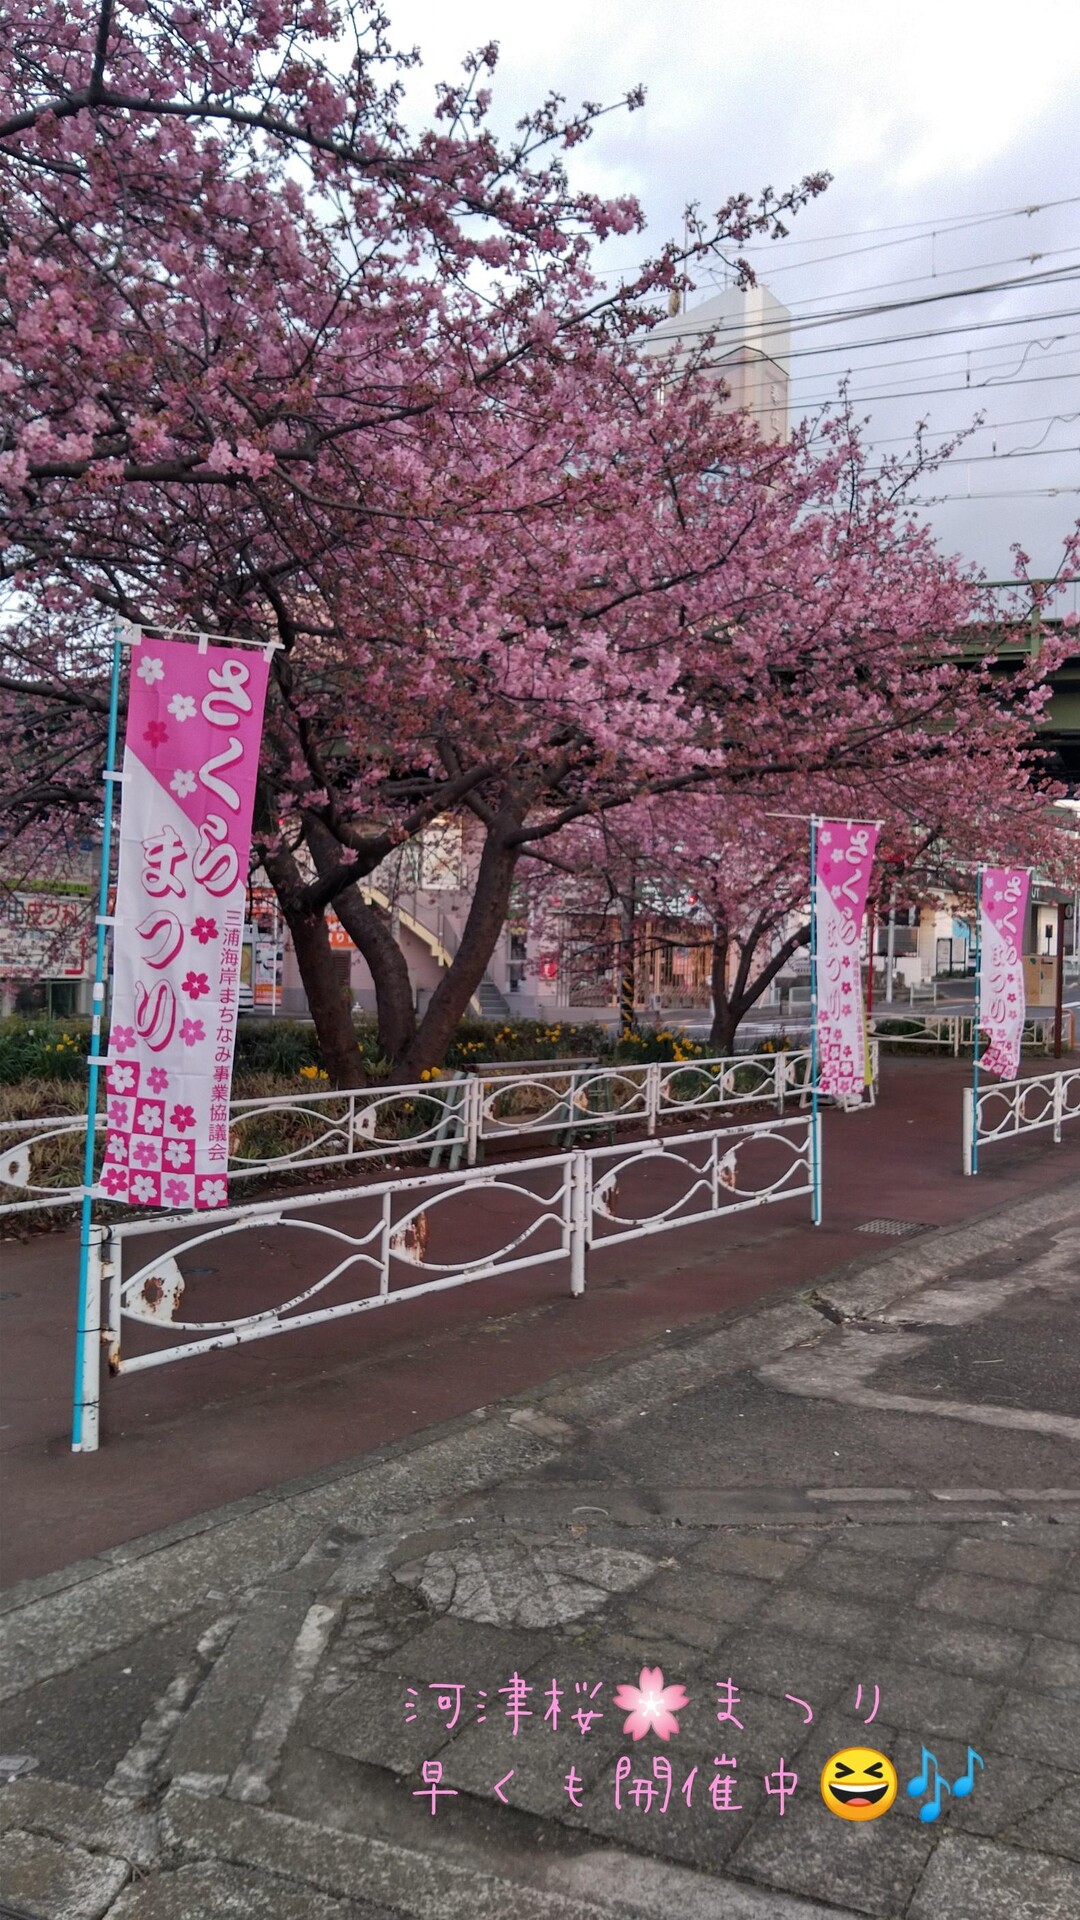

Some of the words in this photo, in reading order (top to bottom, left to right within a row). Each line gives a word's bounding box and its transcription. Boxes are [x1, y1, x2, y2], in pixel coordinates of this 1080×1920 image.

[192, 658, 252, 898] さくら
[838, 829, 870, 946] さくら
[134, 824, 188, 1052] まつり
[1002, 875, 1022, 966] さくら
[207, 908, 243, 1163] 三浦海岸まちなみ事業協議会
